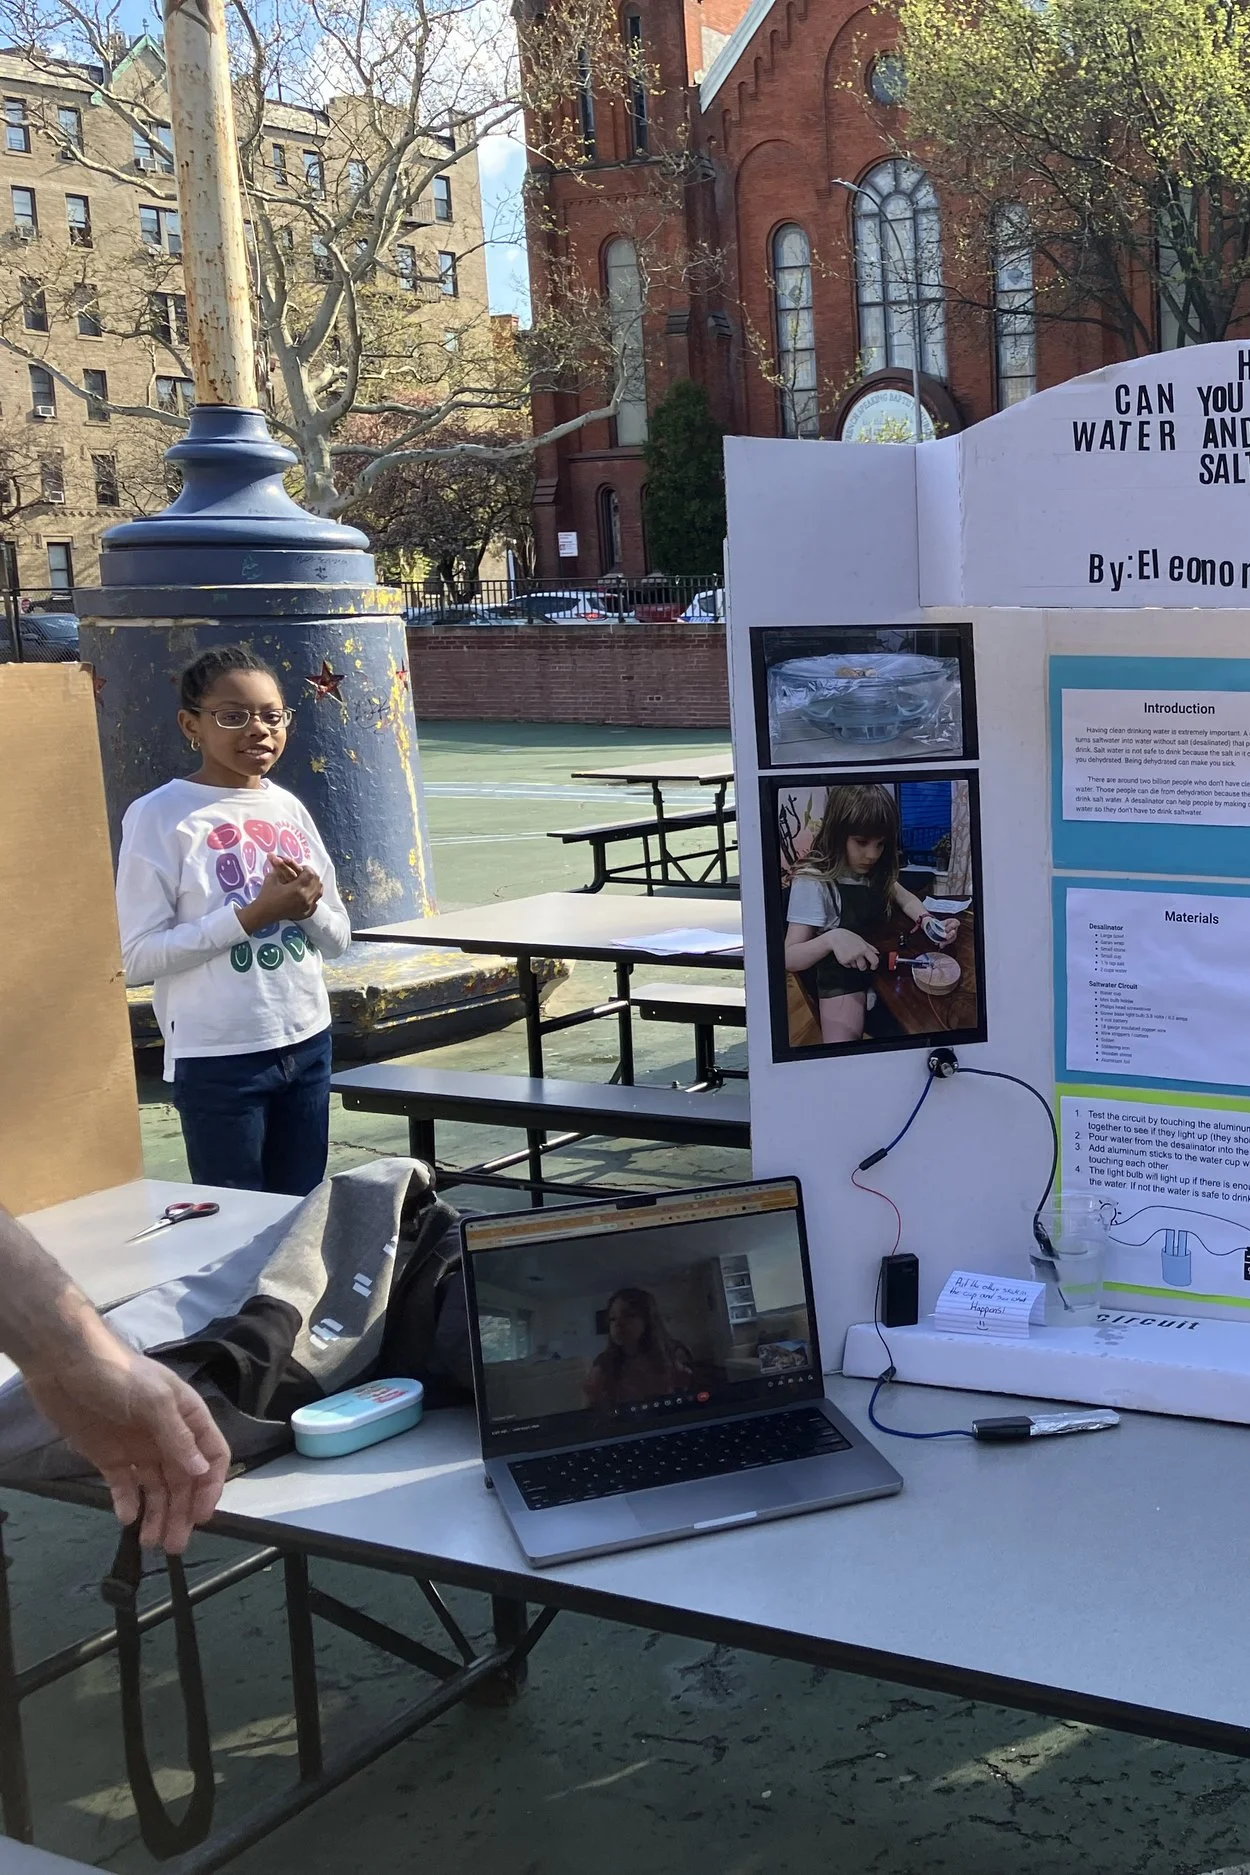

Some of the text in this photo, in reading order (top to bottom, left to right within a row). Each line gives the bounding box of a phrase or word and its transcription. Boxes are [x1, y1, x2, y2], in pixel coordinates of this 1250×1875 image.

[1116, 383, 1174, 416] CAN
[1197, 382, 1243, 418] YOU
[1073, 420, 1175, 452] WATER
[1145, 703, 1215, 714] Introduction
[1089, 923, 1124, 931] Desalinator
[1165, 910, 1219, 925] Materials
[1089, 980, 1138, 990] Saltwater Circuit
[1088, 1110, 1105, 1120] Test
[1107, 1112, 1120, 1121] the
[1122, 1115, 1146, 1123] circuit
[1148, 1116, 1158, 1126] by
[1160, 1117, 1196, 1130] touching
[1198, 1120, 1211, 1129] the
[1088, 1122, 1122, 1133] together
[1124, 1125, 1132, 1133] to
[1134, 1127, 1149, 1135] see
[1151, 1127, 1156, 1135] if
[1158, 1128, 1176, 1139] they
[1178, 1130, 1195, 1140] light
[1197, 1133, 1208, 1142] up
[1210, 1132, 1232, 1144] (they
[1088, 1132, 1108, 1142] Pour
[1110, 1136, 1133, 1144] water
[1134, 1137, 1153, 1146] from
[1155, 1139, 1168, 1148] the
[1170, 1140, 1216, 1152] desalinator
[1218, 1146, 1234, 1154] into
[1236, 1147, 1249, 1156] the
[1089, 1166, 1105, 1175] The
[1107, 1168, 1124, 1178] light
[1126, 1170, 1144, 1179] bulb
[1160, 1174, 1177, 1184] light
[1180, 1177, 1190, 1186] up
[1192, 1176, 1198, 1185] if
[1200, 1178, 1221, 1188] there
[1223, 1181, 1230, 1189] is
